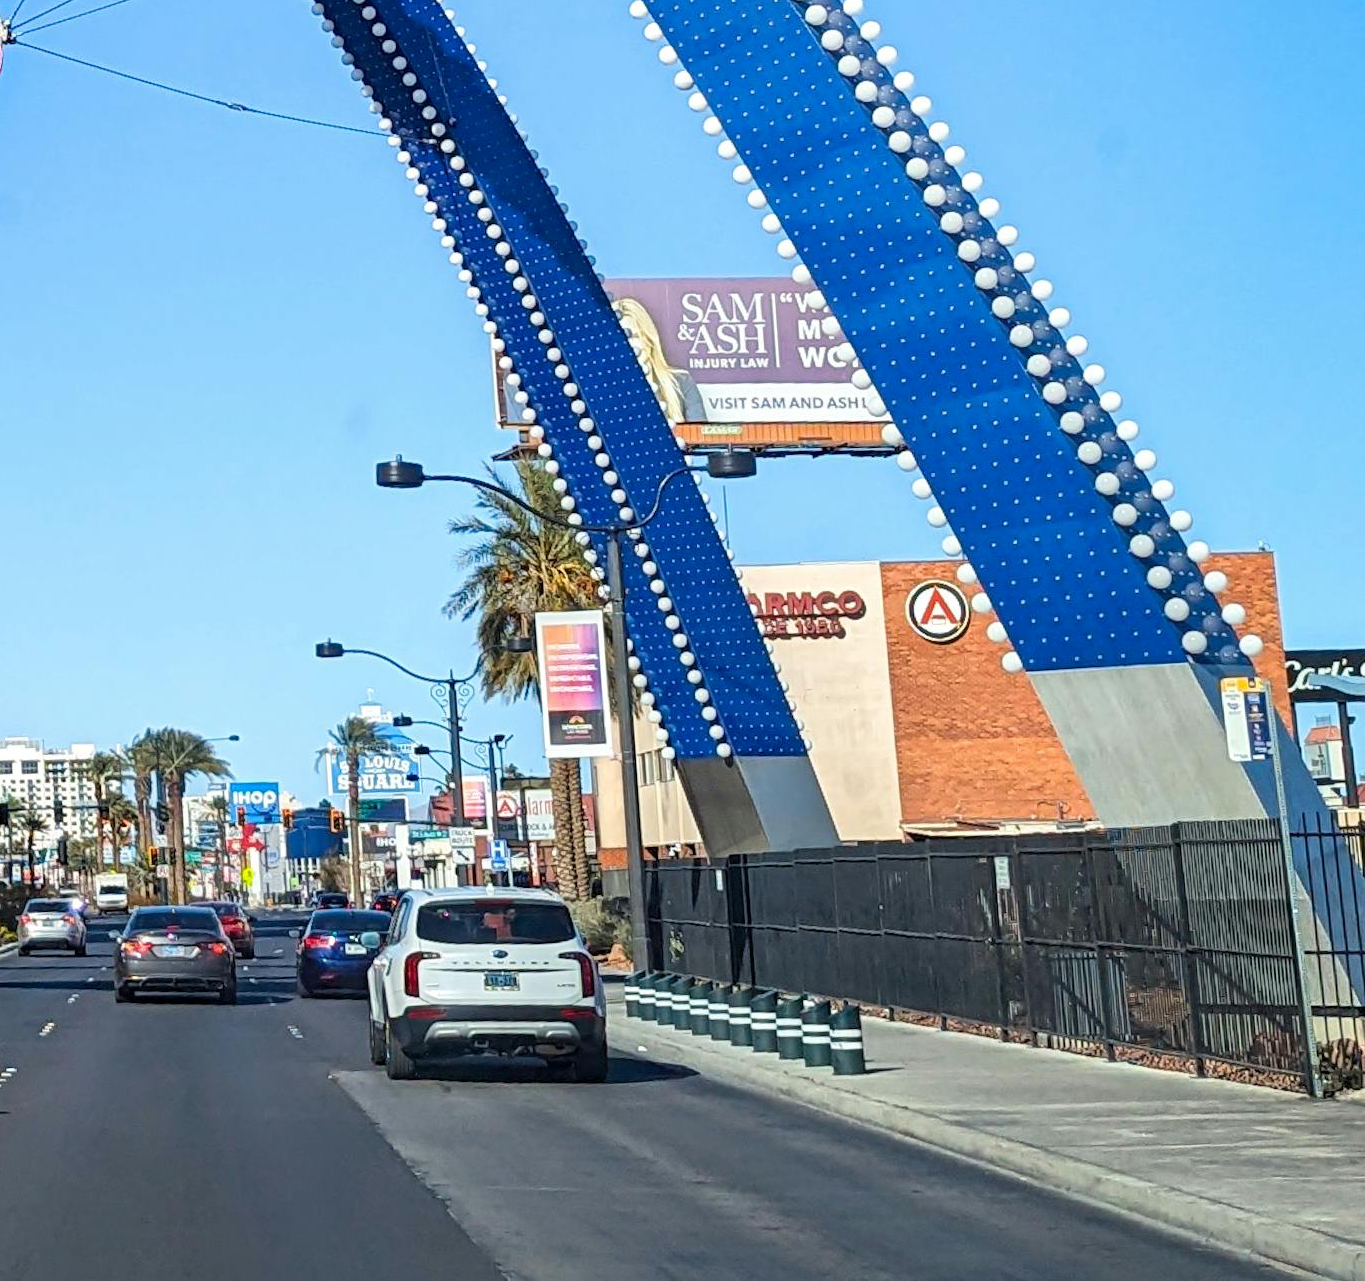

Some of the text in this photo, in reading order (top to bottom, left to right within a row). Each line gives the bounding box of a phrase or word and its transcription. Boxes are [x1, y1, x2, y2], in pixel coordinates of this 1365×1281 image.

[681, 292, 764, 323] SAM
[689, 357, 770, 369] INJURY LAW
[709, 397, 747, 409] VISIT
[751, 397, 786, 409] SAM
[789, 397, 823, 409] AND
[827, 397, 858, 409] ASH
[747, 590, 863, 616] ARMCO
